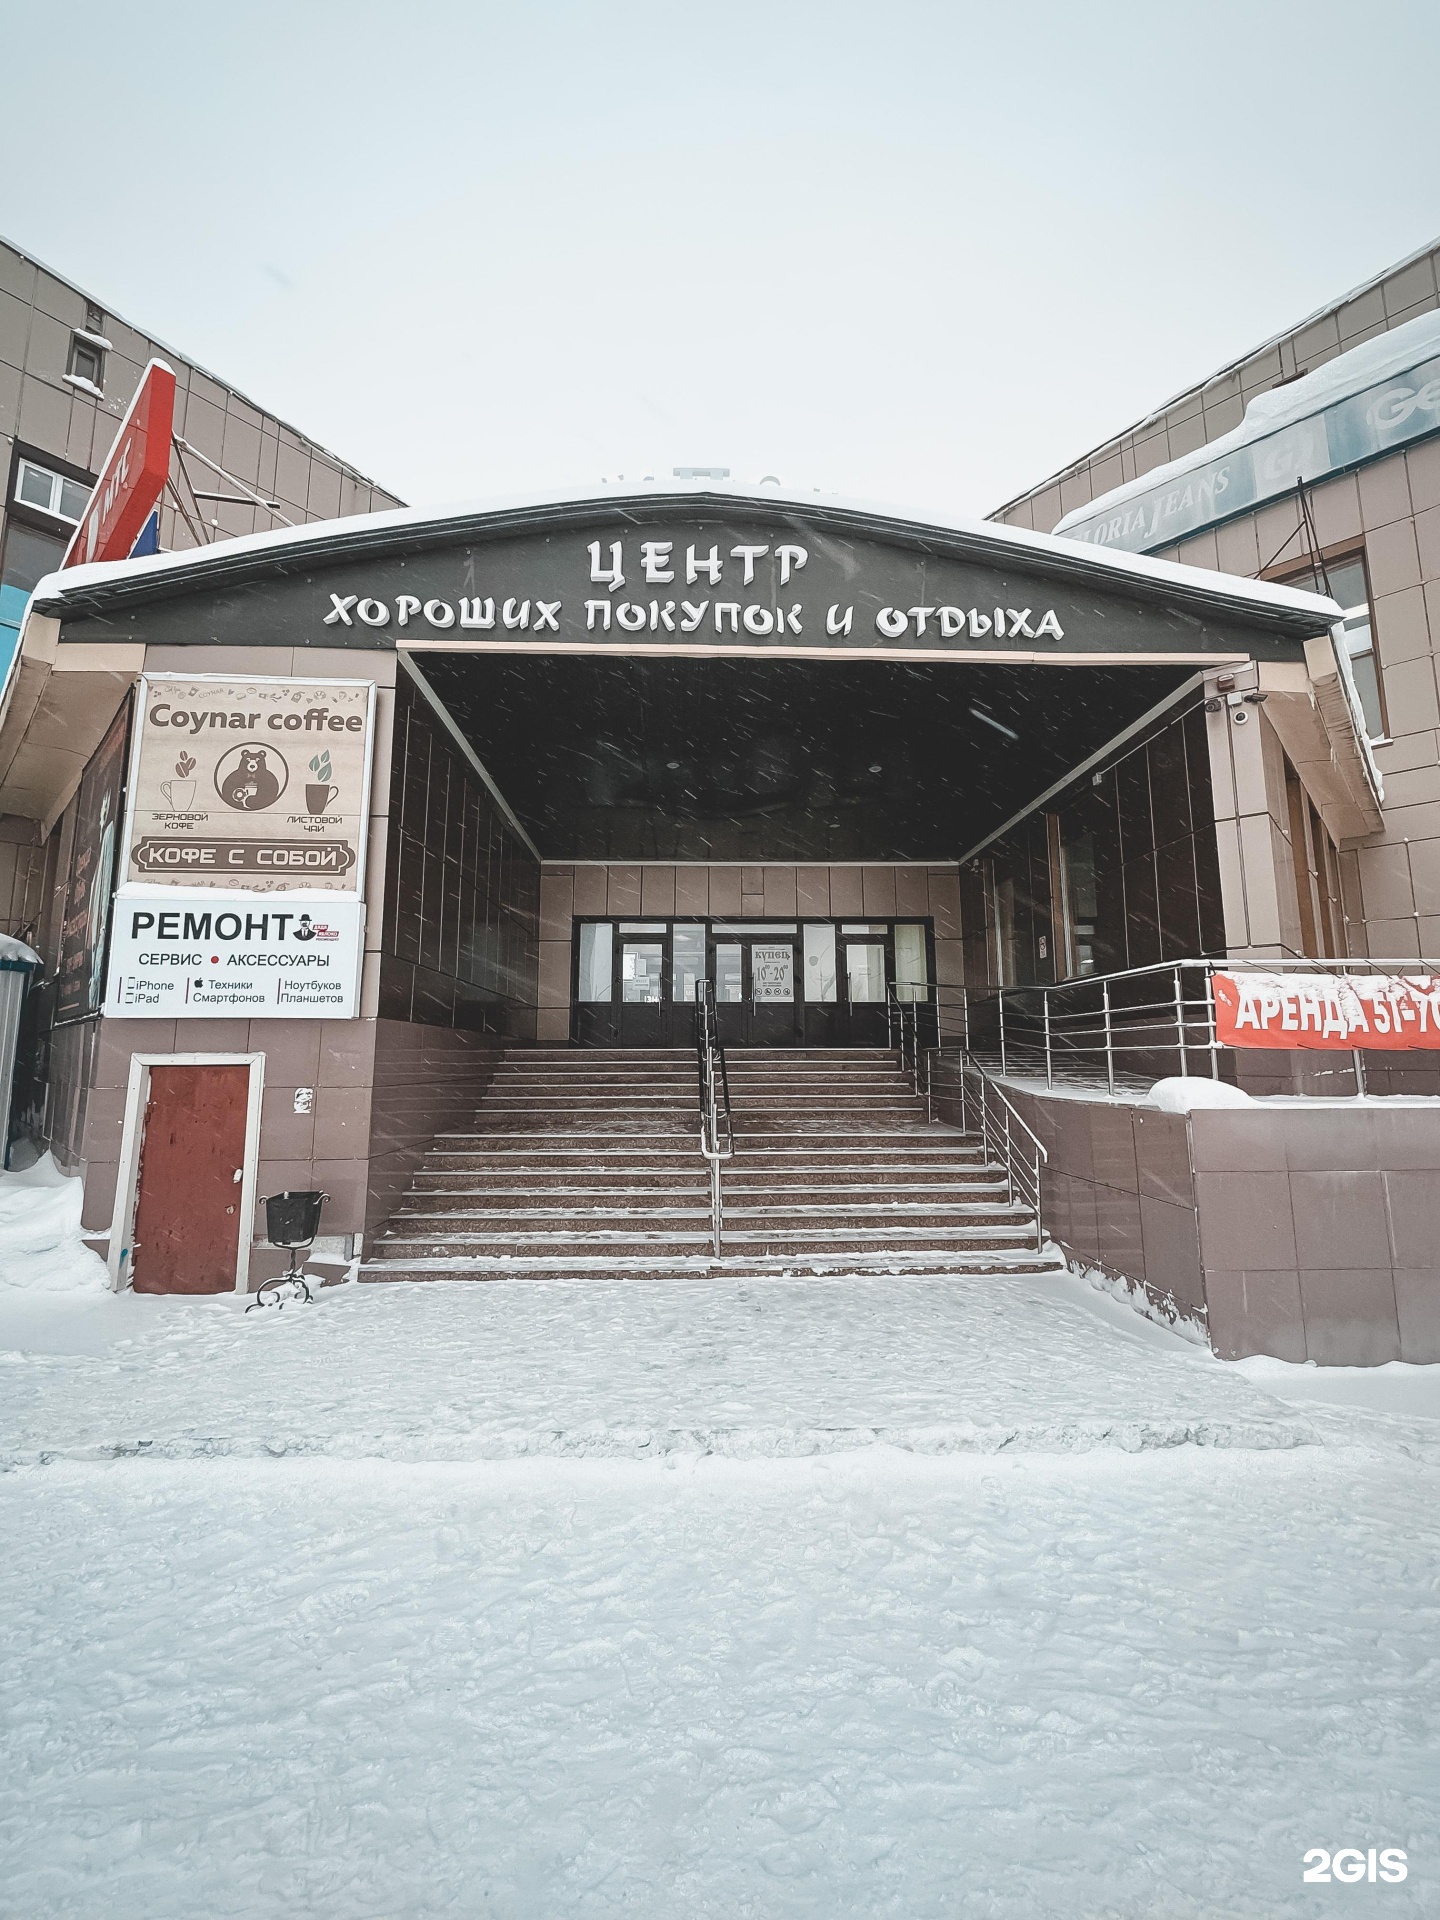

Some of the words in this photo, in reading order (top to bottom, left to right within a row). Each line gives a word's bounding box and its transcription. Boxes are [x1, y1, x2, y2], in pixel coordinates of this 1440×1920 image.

[585, 541, 809, 592] ЦЕНТР
[323, 593, 561, 631] ХОРОШИХ
[584, 599, 803, 636] ПОКУПОК
[826, 604, 853, 637] И
[874, 607, 1065, 640] ОТДЫХА
[149, 703, 261, 735] Coynar
[267, 707, 363, 732] coffee
[151, 812, 209, 822] ЗЕРНОВОЙ
[286, 815, 343, 824] ЛИСТОВОЙ
[164, 822, 194, 830] КОФЕ
[303, 823, 325, 832] ЧАЙ
[148, 847, 217, 864] КОФЕ
[228, 848, 245, 864] С
[256, 846, 338, 866] СОБОЙ
[131, 912, 294, 941] РЕМОНТ
[138, 953, 203, 966] СЕРВИС
[227, 954, 330, 967] АКСЕССУАРЫ
[136, 980, 175, 991] iPhone
[208, 980, 253, 990] Техники
[284, 980, 342, 991] Ноутбуков
[134, 993, 160, 1004] iPad
[192, 992, 266, 1004] Смартфонов
[280, 993, 344, 1004] Планшетов
[1234, 984, 1370, 1040] АРЕНДА
